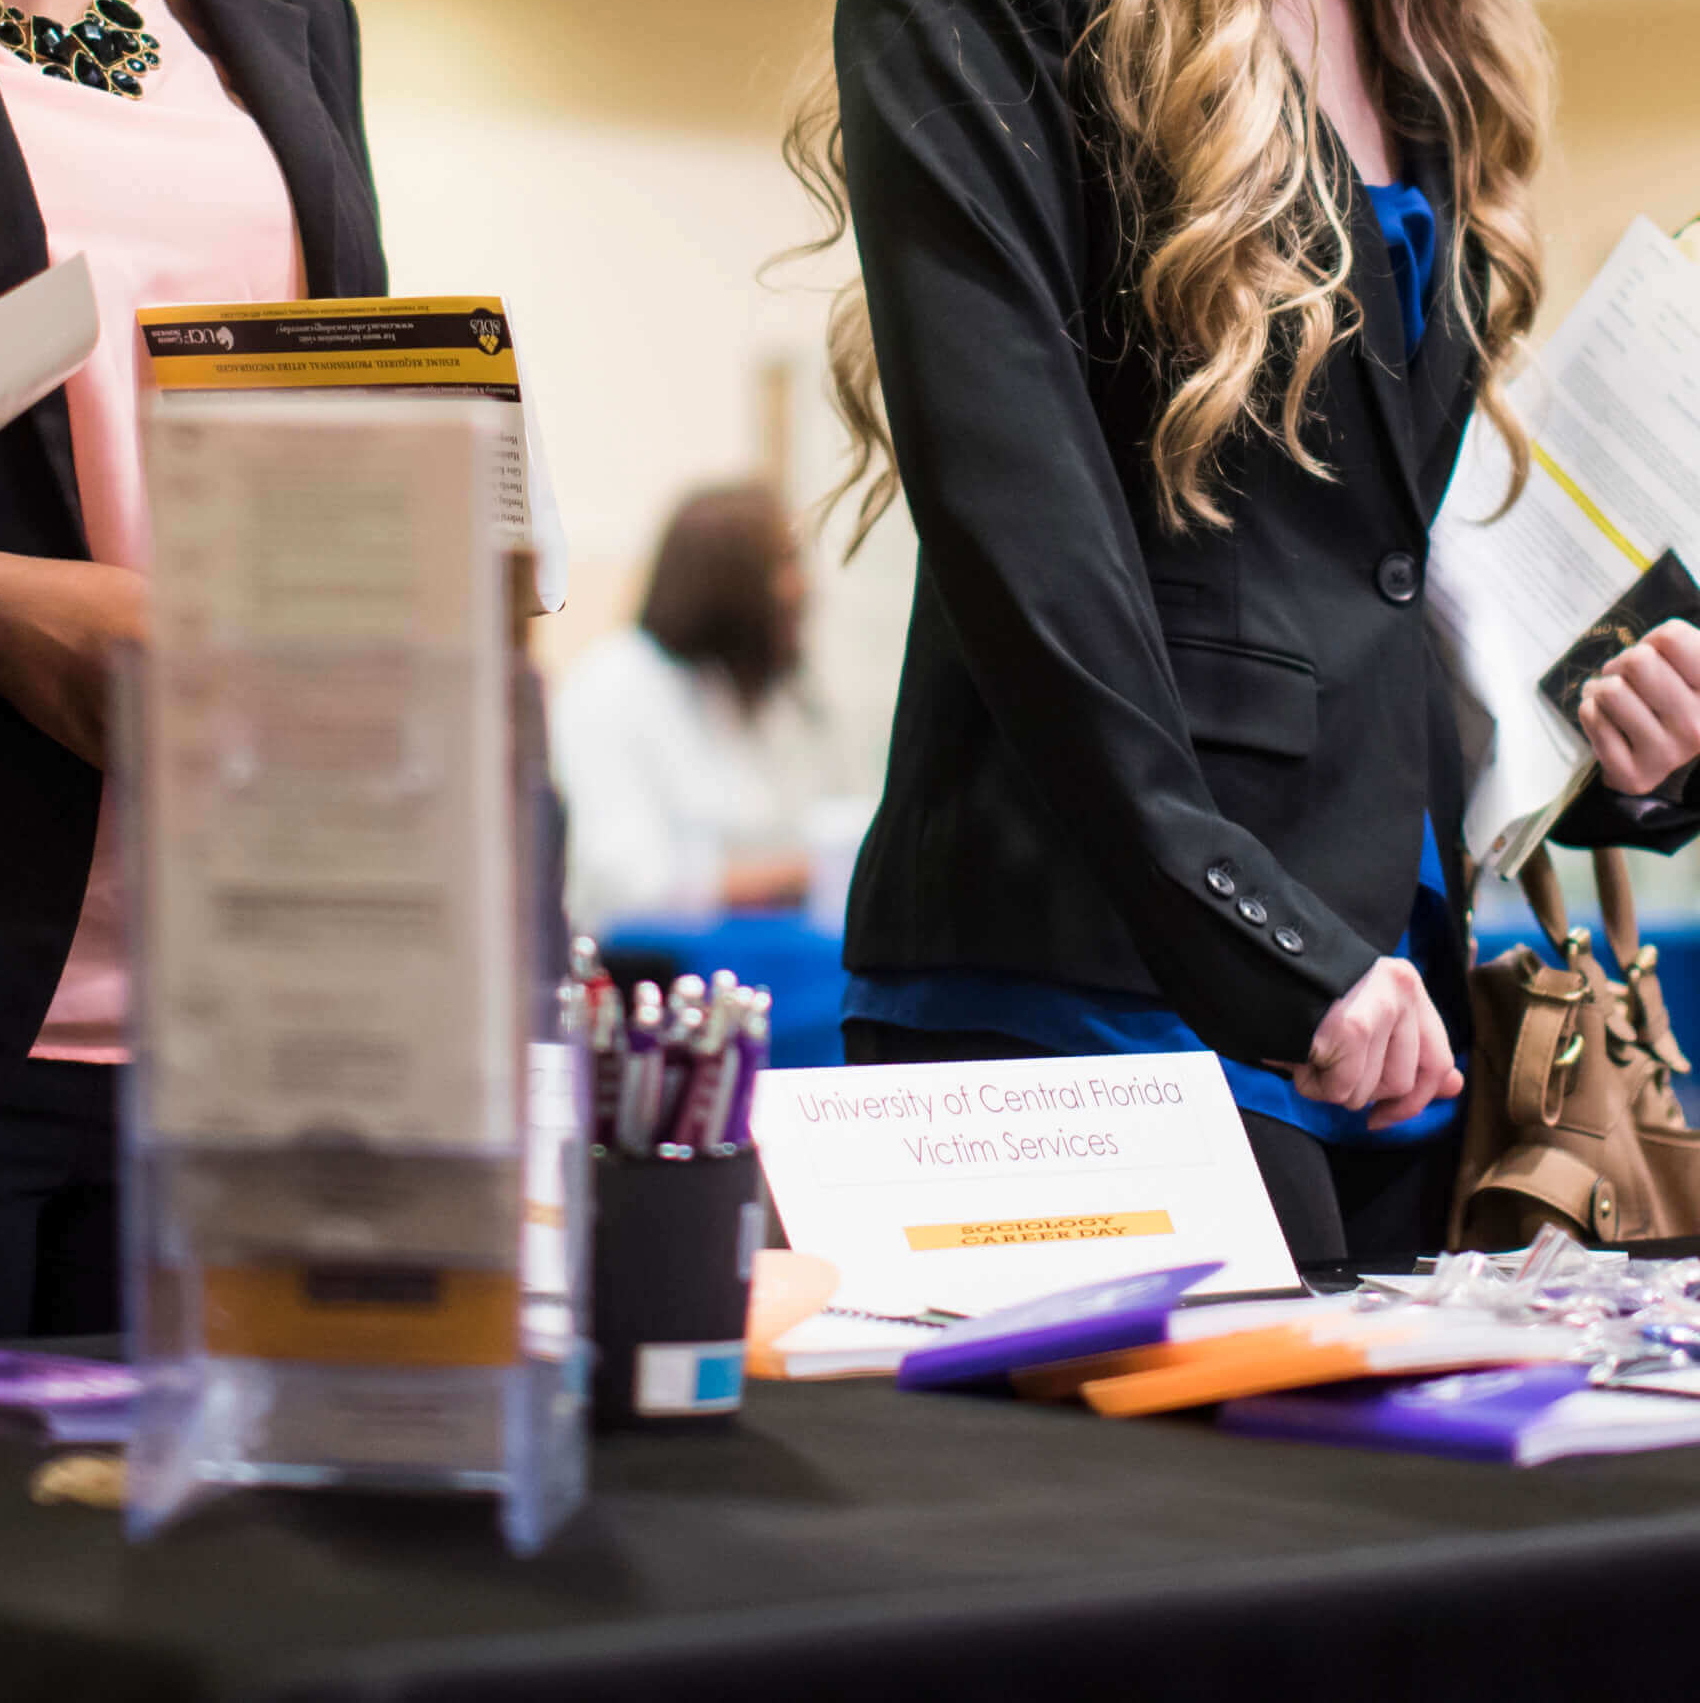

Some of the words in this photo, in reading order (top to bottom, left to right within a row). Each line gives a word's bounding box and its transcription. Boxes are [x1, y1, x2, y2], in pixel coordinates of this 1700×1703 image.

[184, 328, 216, 345] UCF
[277, 362, 307, 371] ATTIRE
[310, 359, 373, 371] PROFESSIONAL
[426, 358, 460, 367] RESUME
[798, 1090, 933, 1123] University
[943, 1086, 971, 1116] of
[979, 1079, 1083, 1114] Central
[1089, 1076, 1183, 1108] Florida
[904, 1131, 999, 1166] Victim
[1002, 1128, 1120, 1163] Services
[961, 1216, 1115, 1235] SOCIOLOGY
[961, 1229, 1071, 1246] CAREER
[1079, 1225, 1129, 1239] DAY
